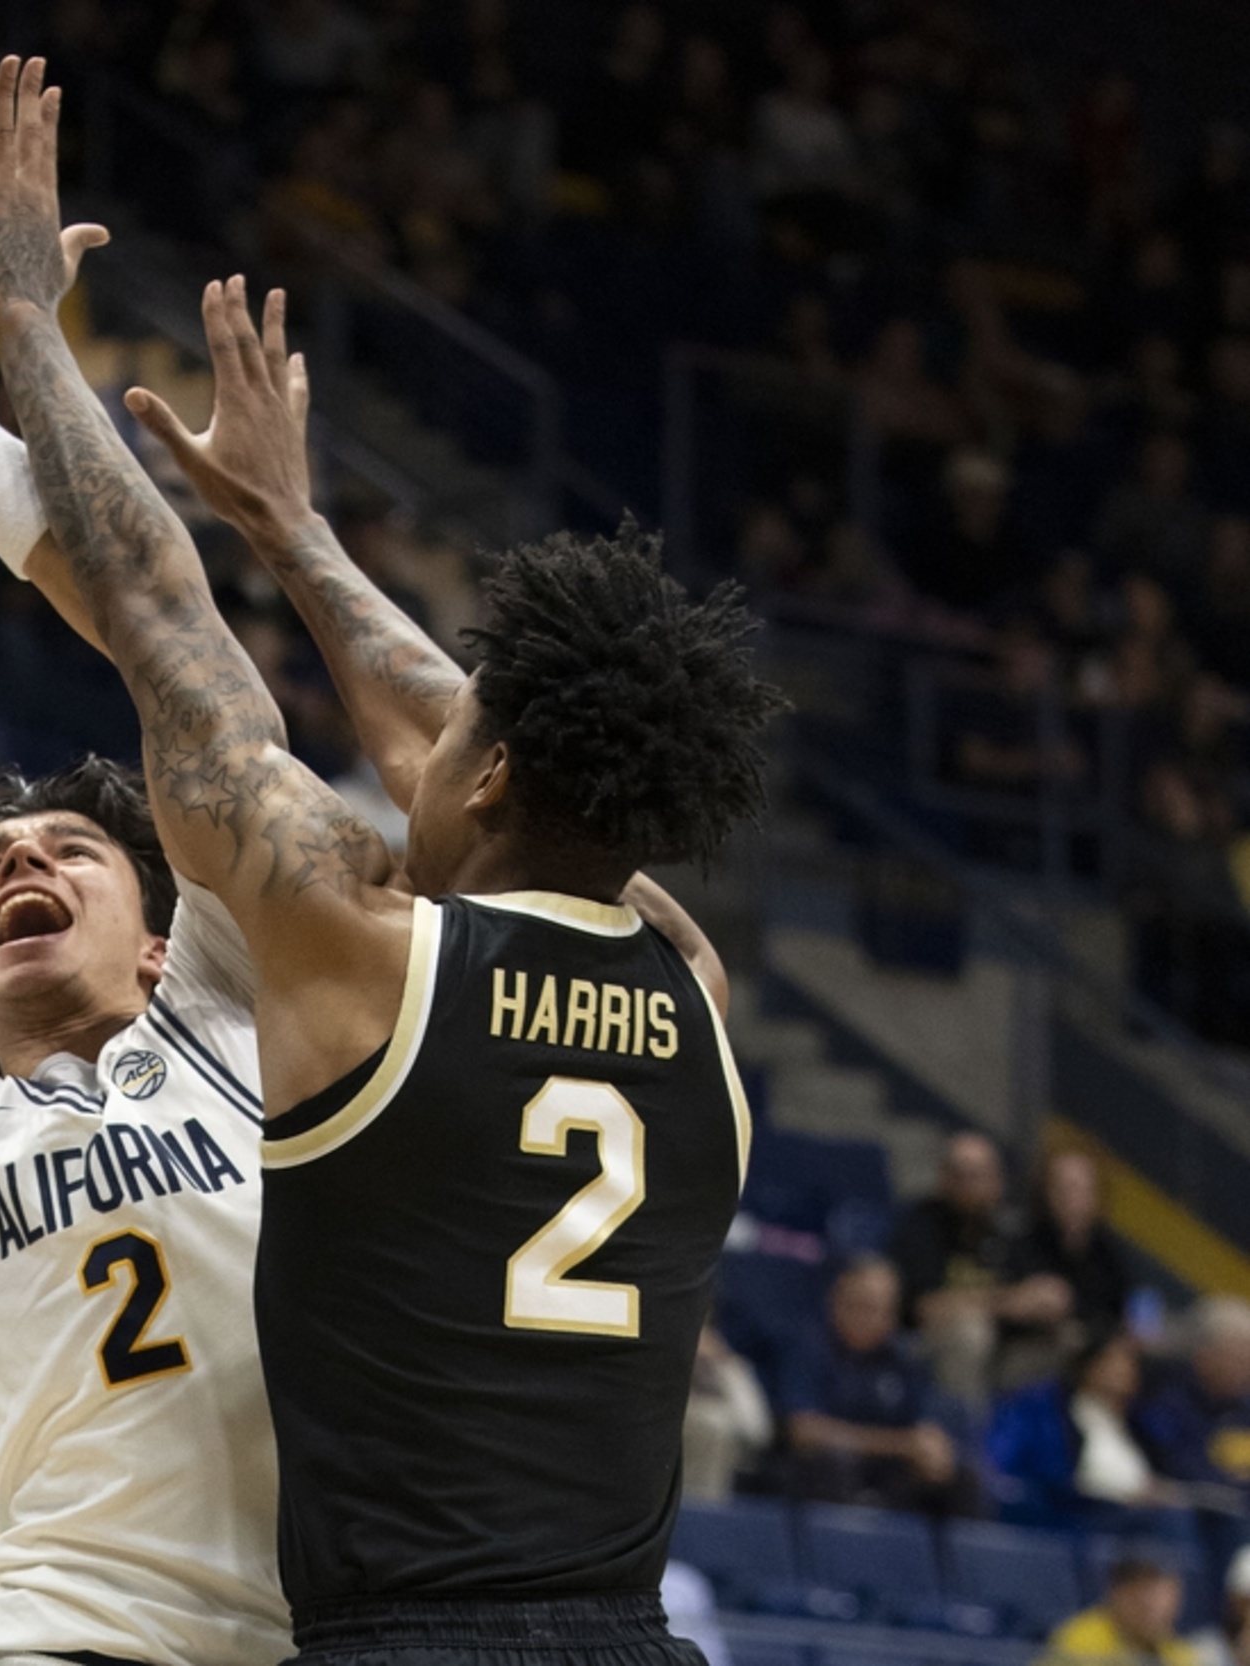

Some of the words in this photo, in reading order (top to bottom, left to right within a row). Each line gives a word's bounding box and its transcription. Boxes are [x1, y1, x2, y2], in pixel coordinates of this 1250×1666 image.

[490, 967, 679, 1060] HARRIS
[504, 1074, 646, 1339] 2
[76, 1226, 193, 1391] 2
